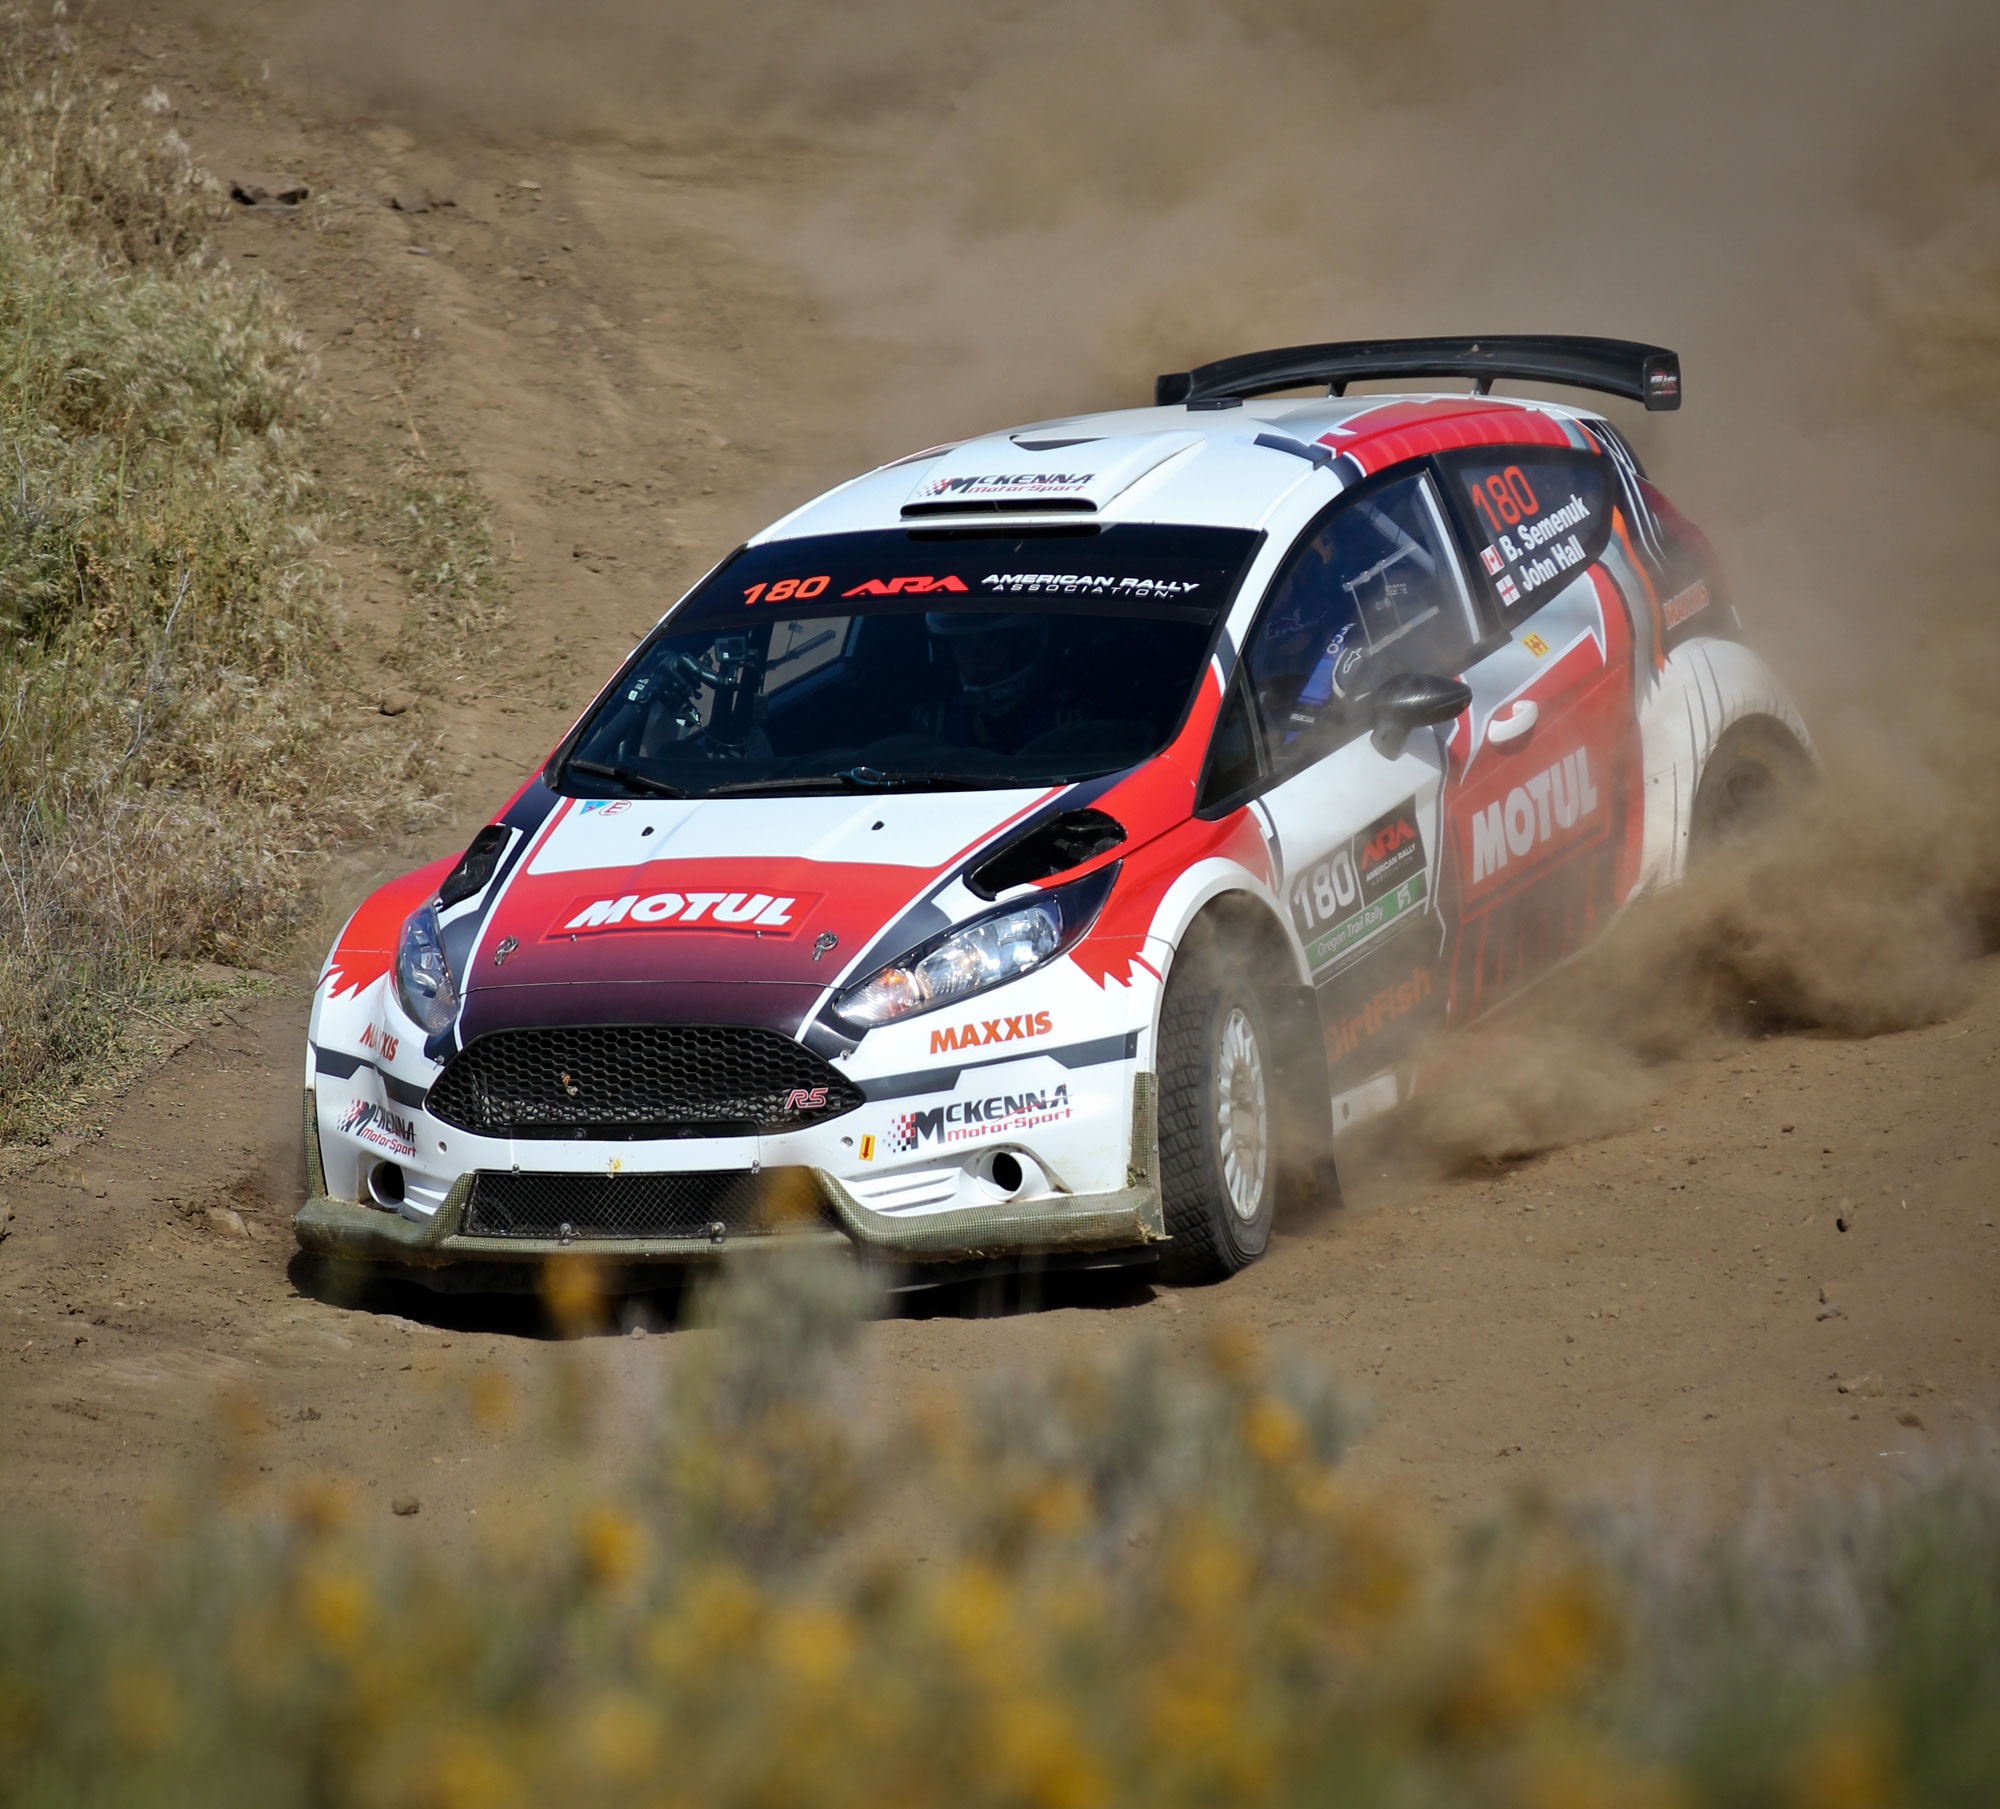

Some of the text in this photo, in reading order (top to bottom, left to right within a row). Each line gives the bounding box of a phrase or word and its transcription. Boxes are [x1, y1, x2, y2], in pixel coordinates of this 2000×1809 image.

[1472, 465, 1539, 532] 180
[1499, 494, 1591, 562] B. Semenuk
[981, 574, 1200, 593] AMERICAN RALLY
[1522, 534, 1587, 592] John Hall
[743, 575, 969, 605] 180 ARA
[1472, 746, 1598, 884] MOTUL
[1360, 817, 1417, 871] ARA
[1366, 842, 1417, 882] AMERICAN RALLY
[564, 892, 796, 929] MOTUL
[1294, 850, 1356, 929] 180
[1318, 904, 1385, 957] Oregon Trail Rally
[929, 1010, 1053, 1055] MAXXIS
[785, 1087, 829, 1110] RS
